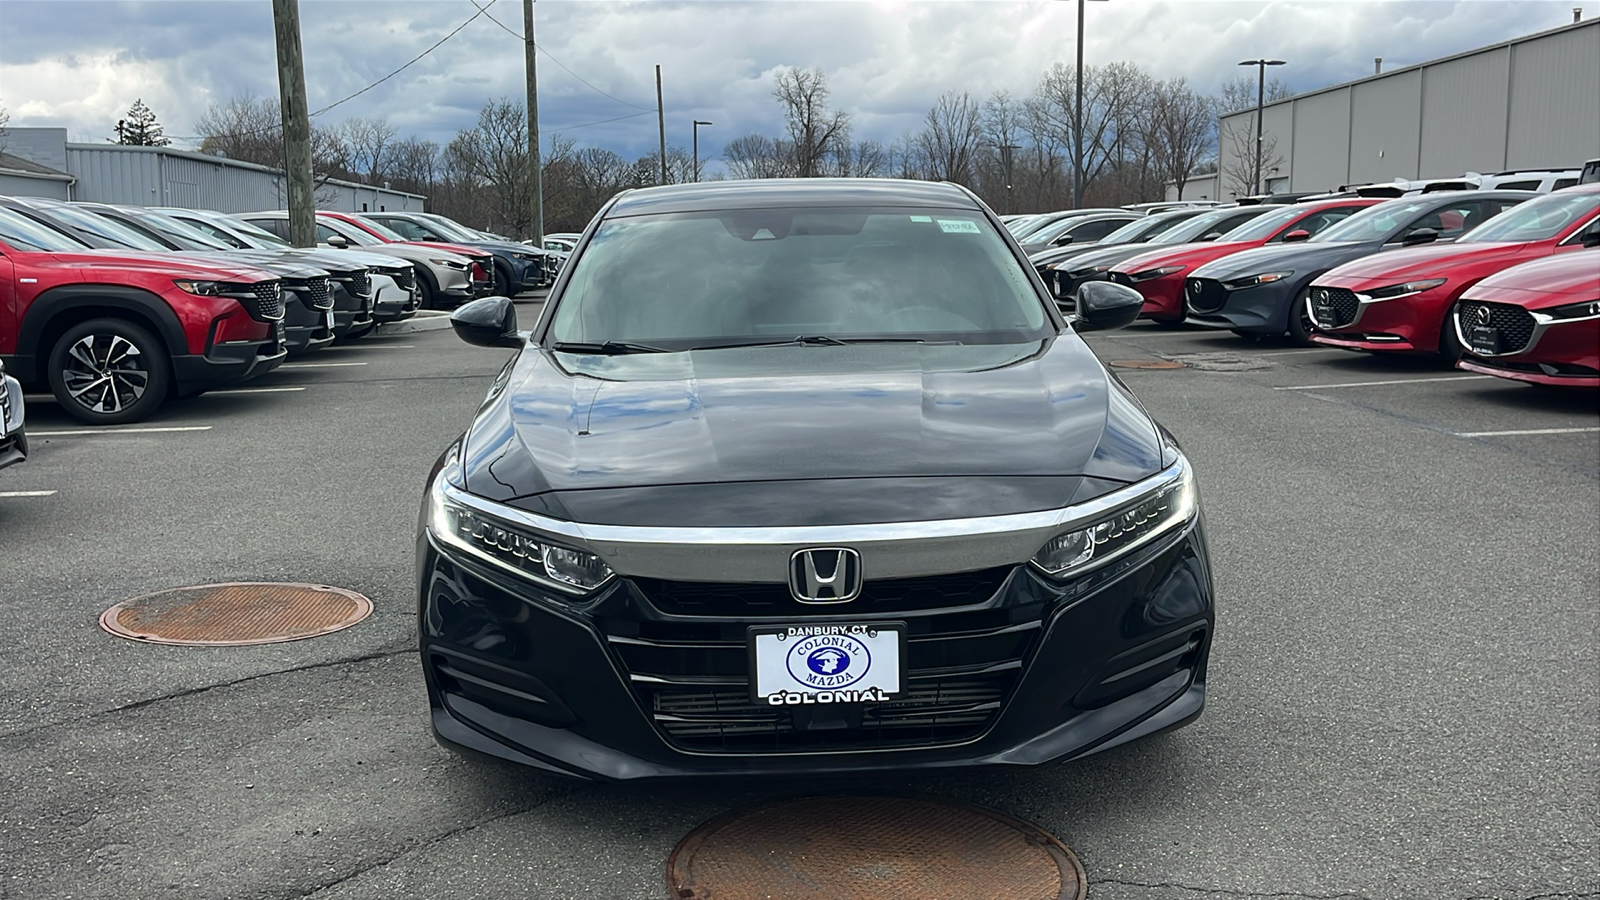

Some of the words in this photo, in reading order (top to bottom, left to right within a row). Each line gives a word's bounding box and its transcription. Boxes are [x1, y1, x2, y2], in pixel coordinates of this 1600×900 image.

[788, 626, 849, 637] DANBURY,
[851, 625, 868, 634] CT
[797, 637, 860, 656] COLONIAL
[806, 672, 854, 686] MAZDA
[768, 690, 890, 705] COLONIAL
